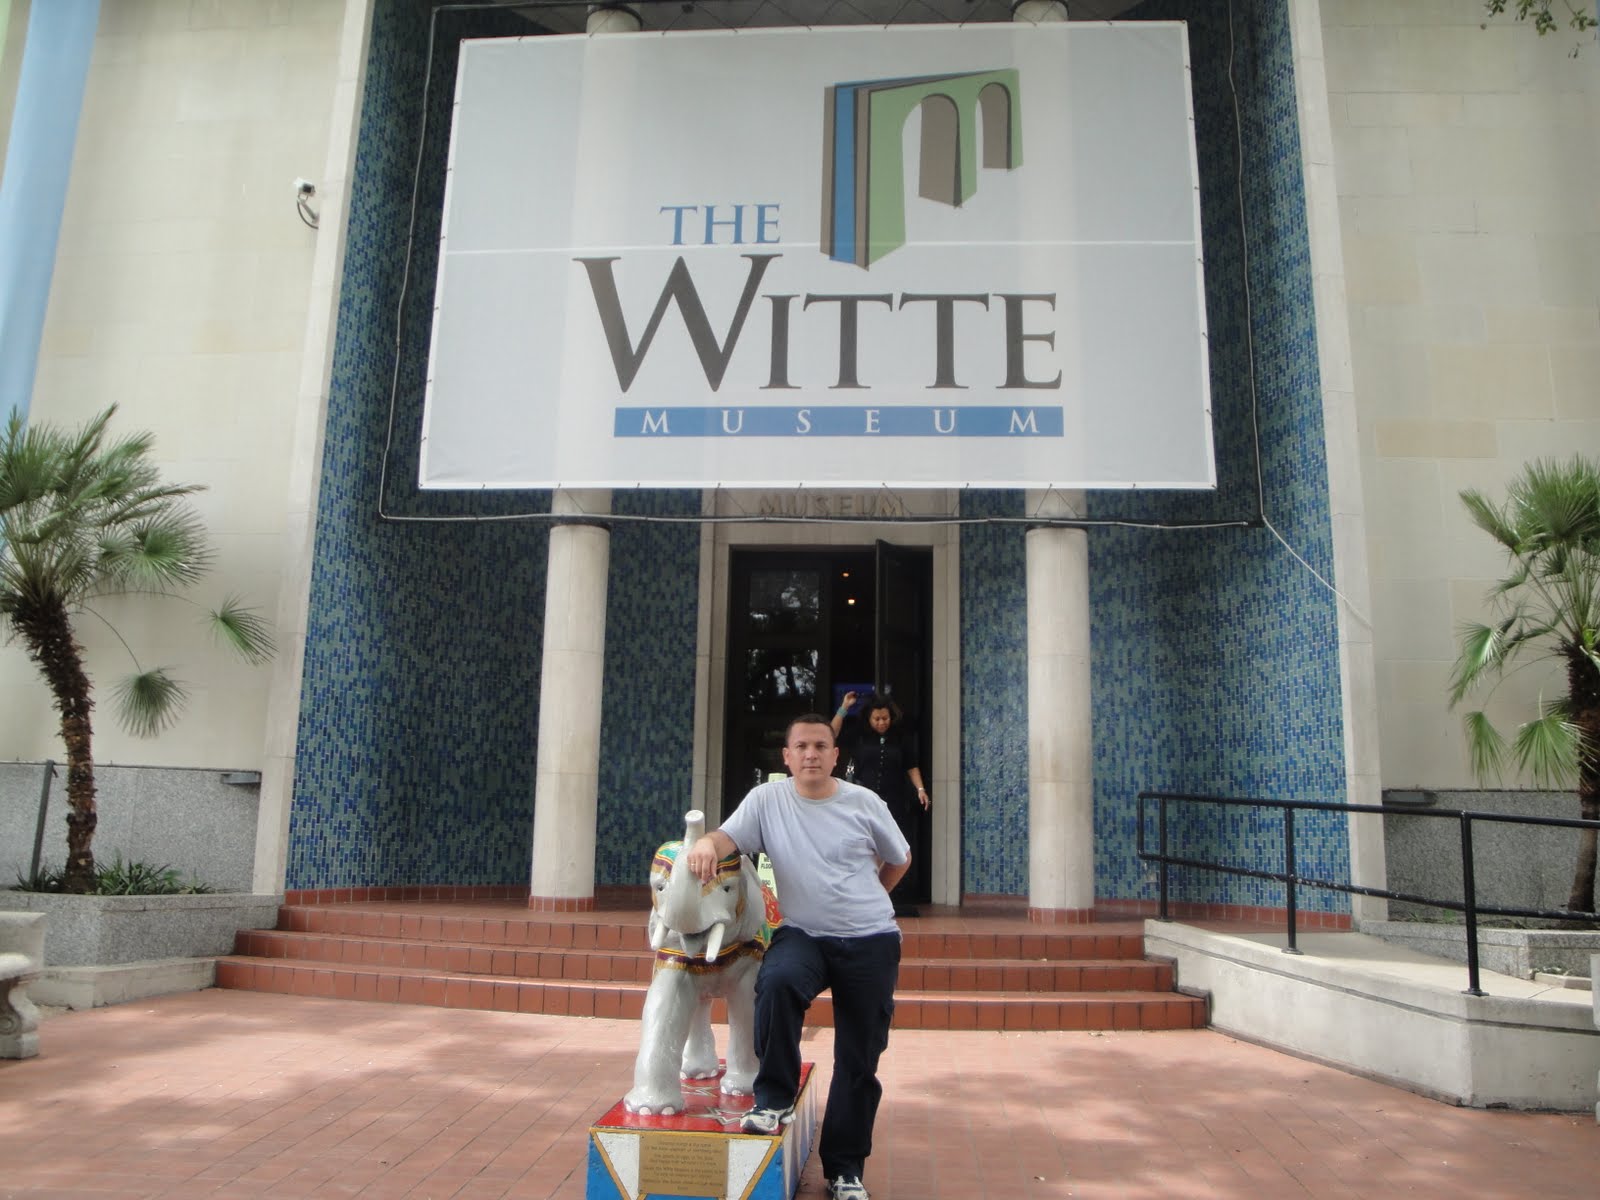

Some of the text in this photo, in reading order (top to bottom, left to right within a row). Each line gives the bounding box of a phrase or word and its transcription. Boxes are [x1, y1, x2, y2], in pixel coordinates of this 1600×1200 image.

[660, 203, 781, 246] THE
[572, 253, 1063, 394] WITTE
[641, 409, 1040, 434] MUSEUM
[758, 493, 906, 517] MUSEUM
